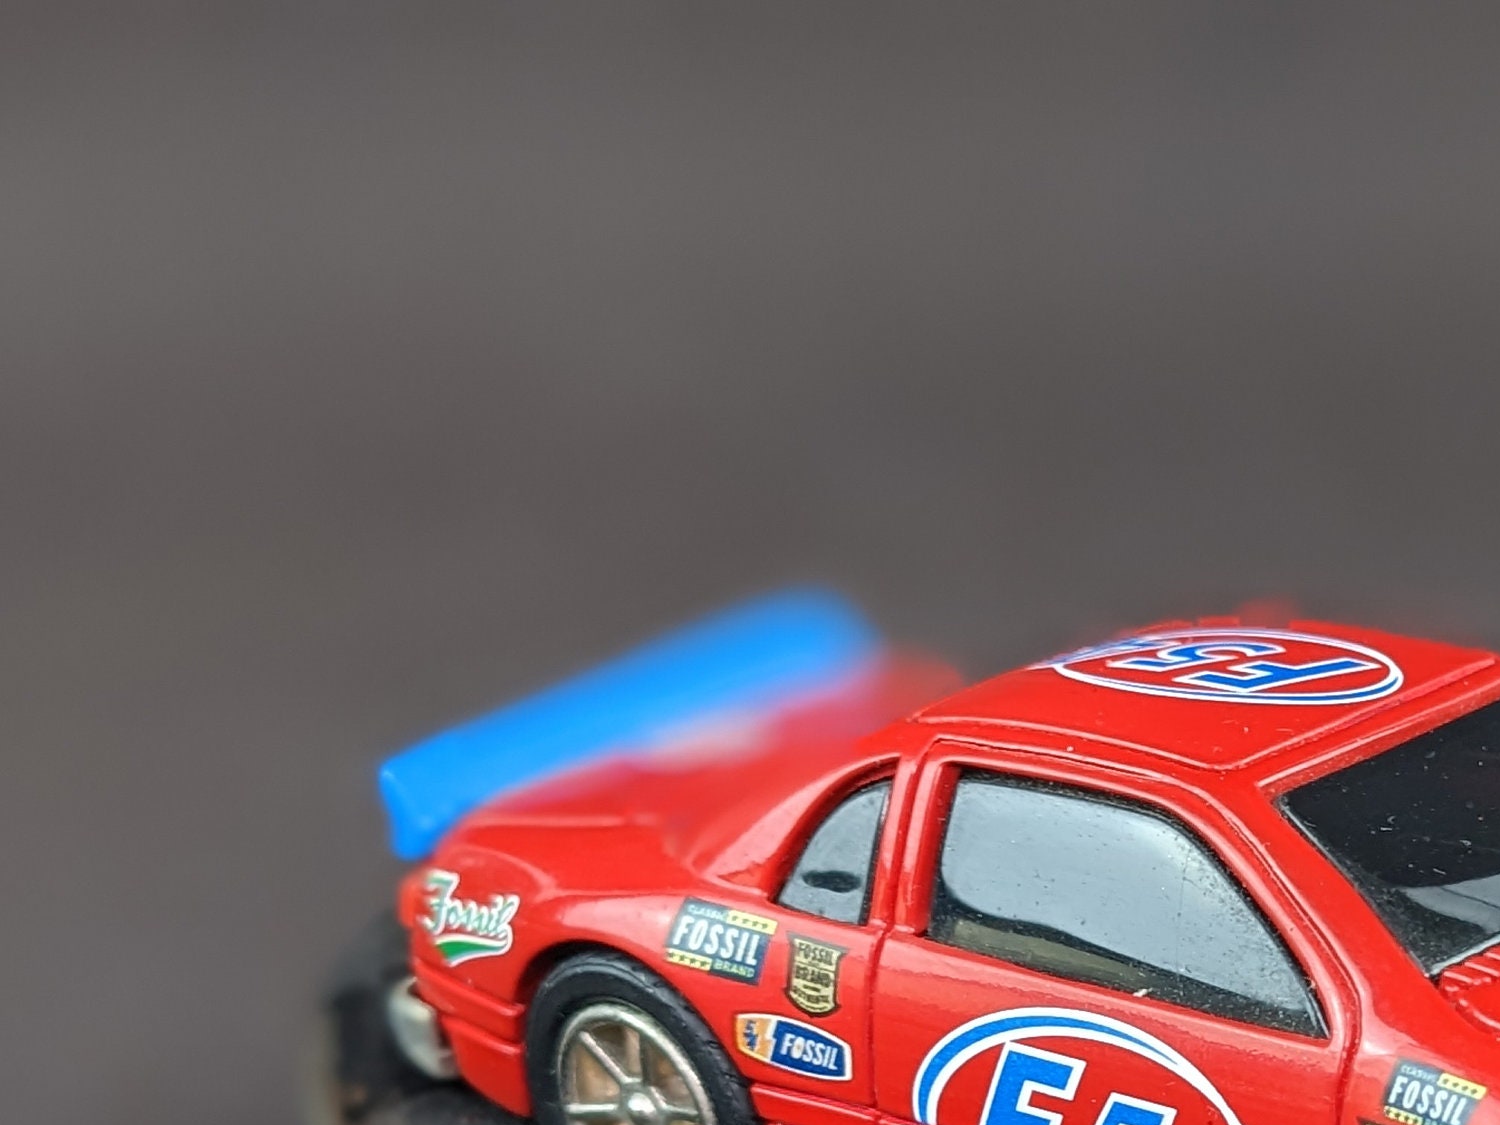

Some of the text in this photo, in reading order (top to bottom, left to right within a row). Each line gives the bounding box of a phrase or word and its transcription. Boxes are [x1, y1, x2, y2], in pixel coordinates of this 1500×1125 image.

[1026, 636, 1382, 693] F5
[672, 914, 760, 966] FOSSIL
[797, 941, 835, 966] FOSSIL
[712, 958, 756, 978] BRAND
[780, 1032, 839, 1071] FOSSIL
